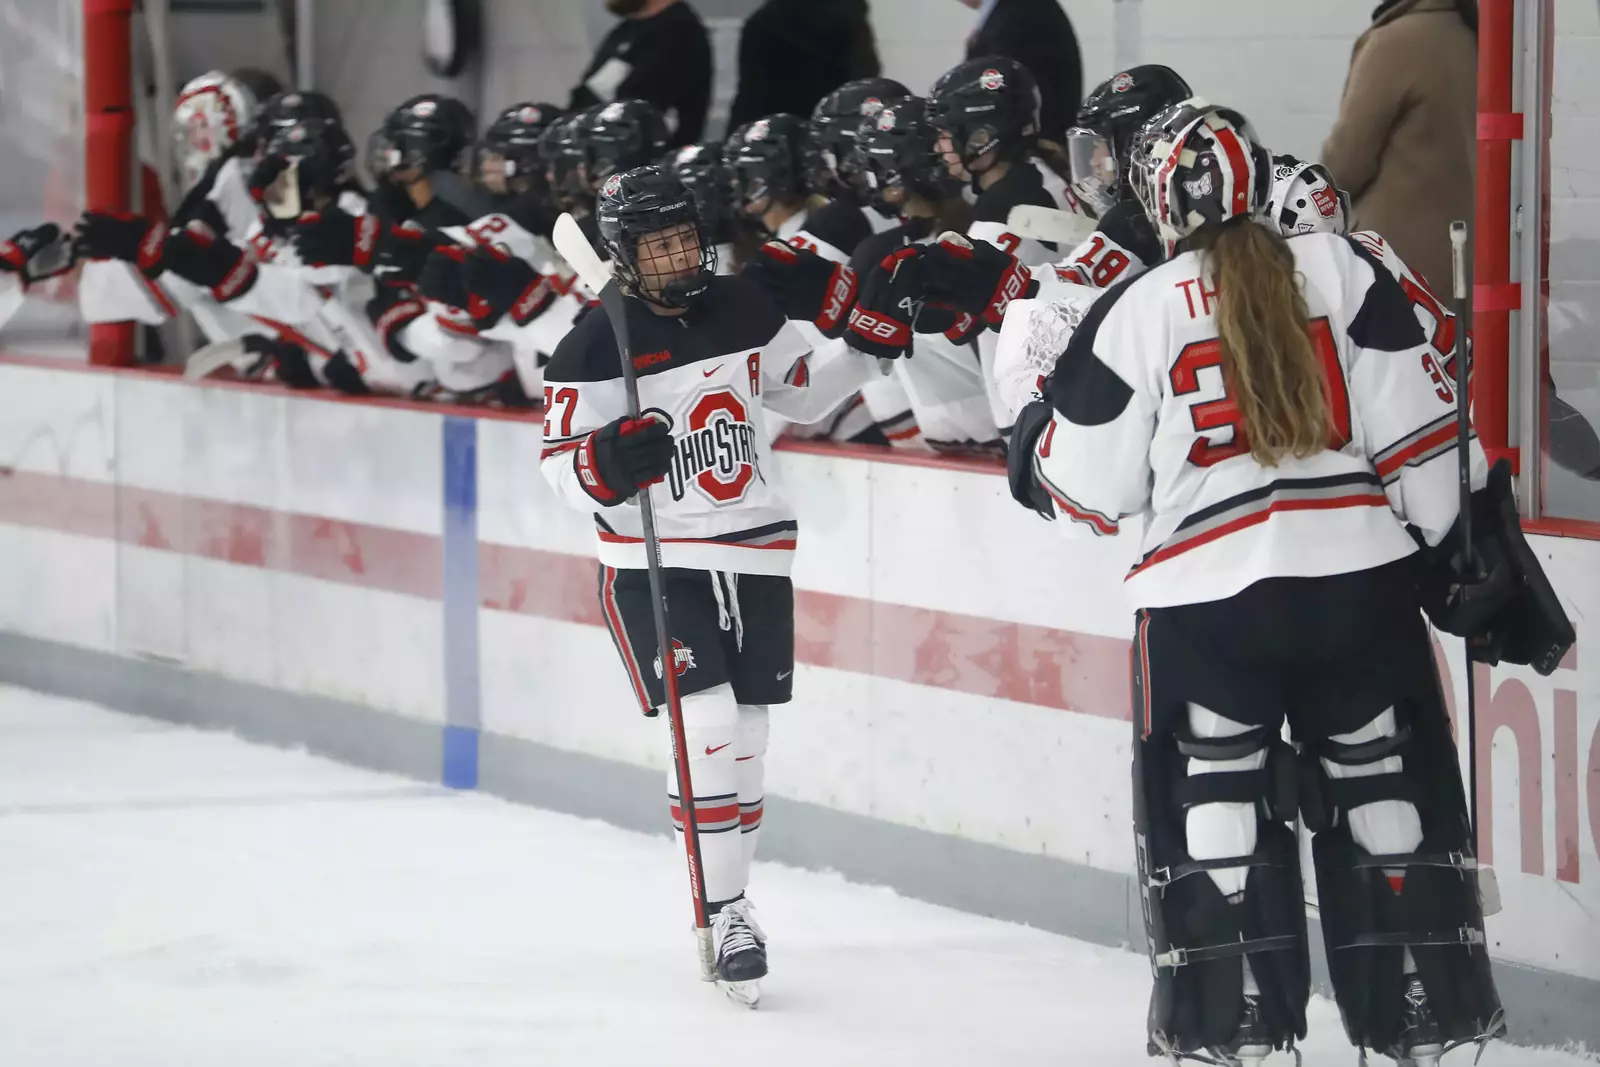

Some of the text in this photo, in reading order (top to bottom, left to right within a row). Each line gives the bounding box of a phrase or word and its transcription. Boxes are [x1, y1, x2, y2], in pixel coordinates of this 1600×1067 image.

[1076, 236, 1131, 288] 18
[747, 352, 760, 397] A
[689, 853, 700, 899] BAUER
